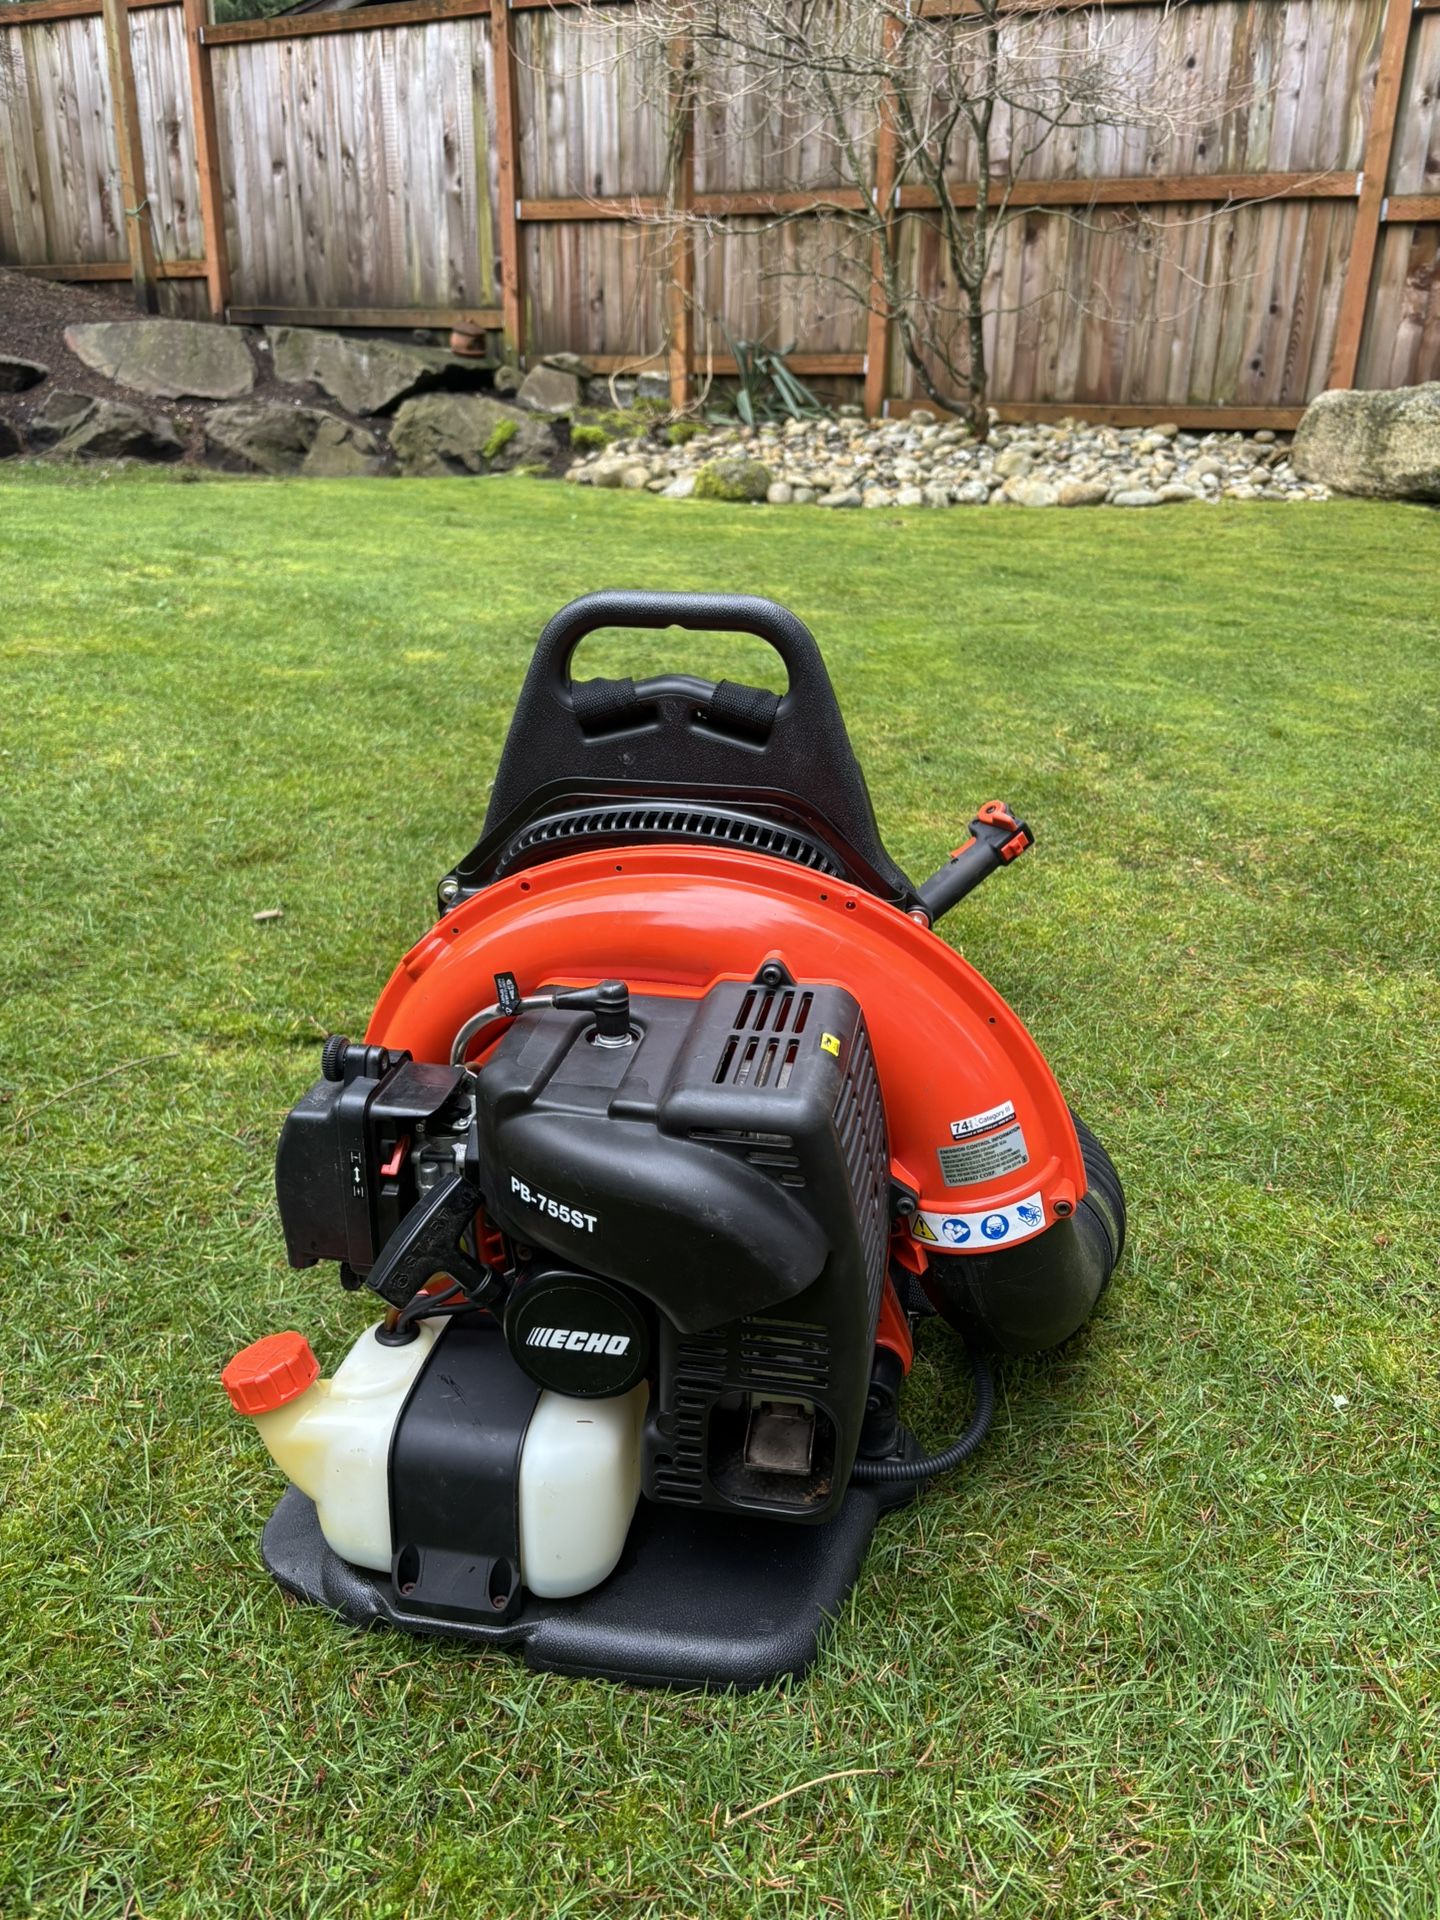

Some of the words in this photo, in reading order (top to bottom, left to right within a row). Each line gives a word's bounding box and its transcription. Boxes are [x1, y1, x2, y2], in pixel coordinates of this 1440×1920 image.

[953, 1121, 968, 1133] 74
[978, 1110, 1005, 1124] Category
[966, 1140, 991, 1150] CONTROL
[992, 1126, 1020, 1142] INFORMATION
[511, 1176, 597, 1233] PB-755ST
[547, 1329, 630, 1356] ECHO
